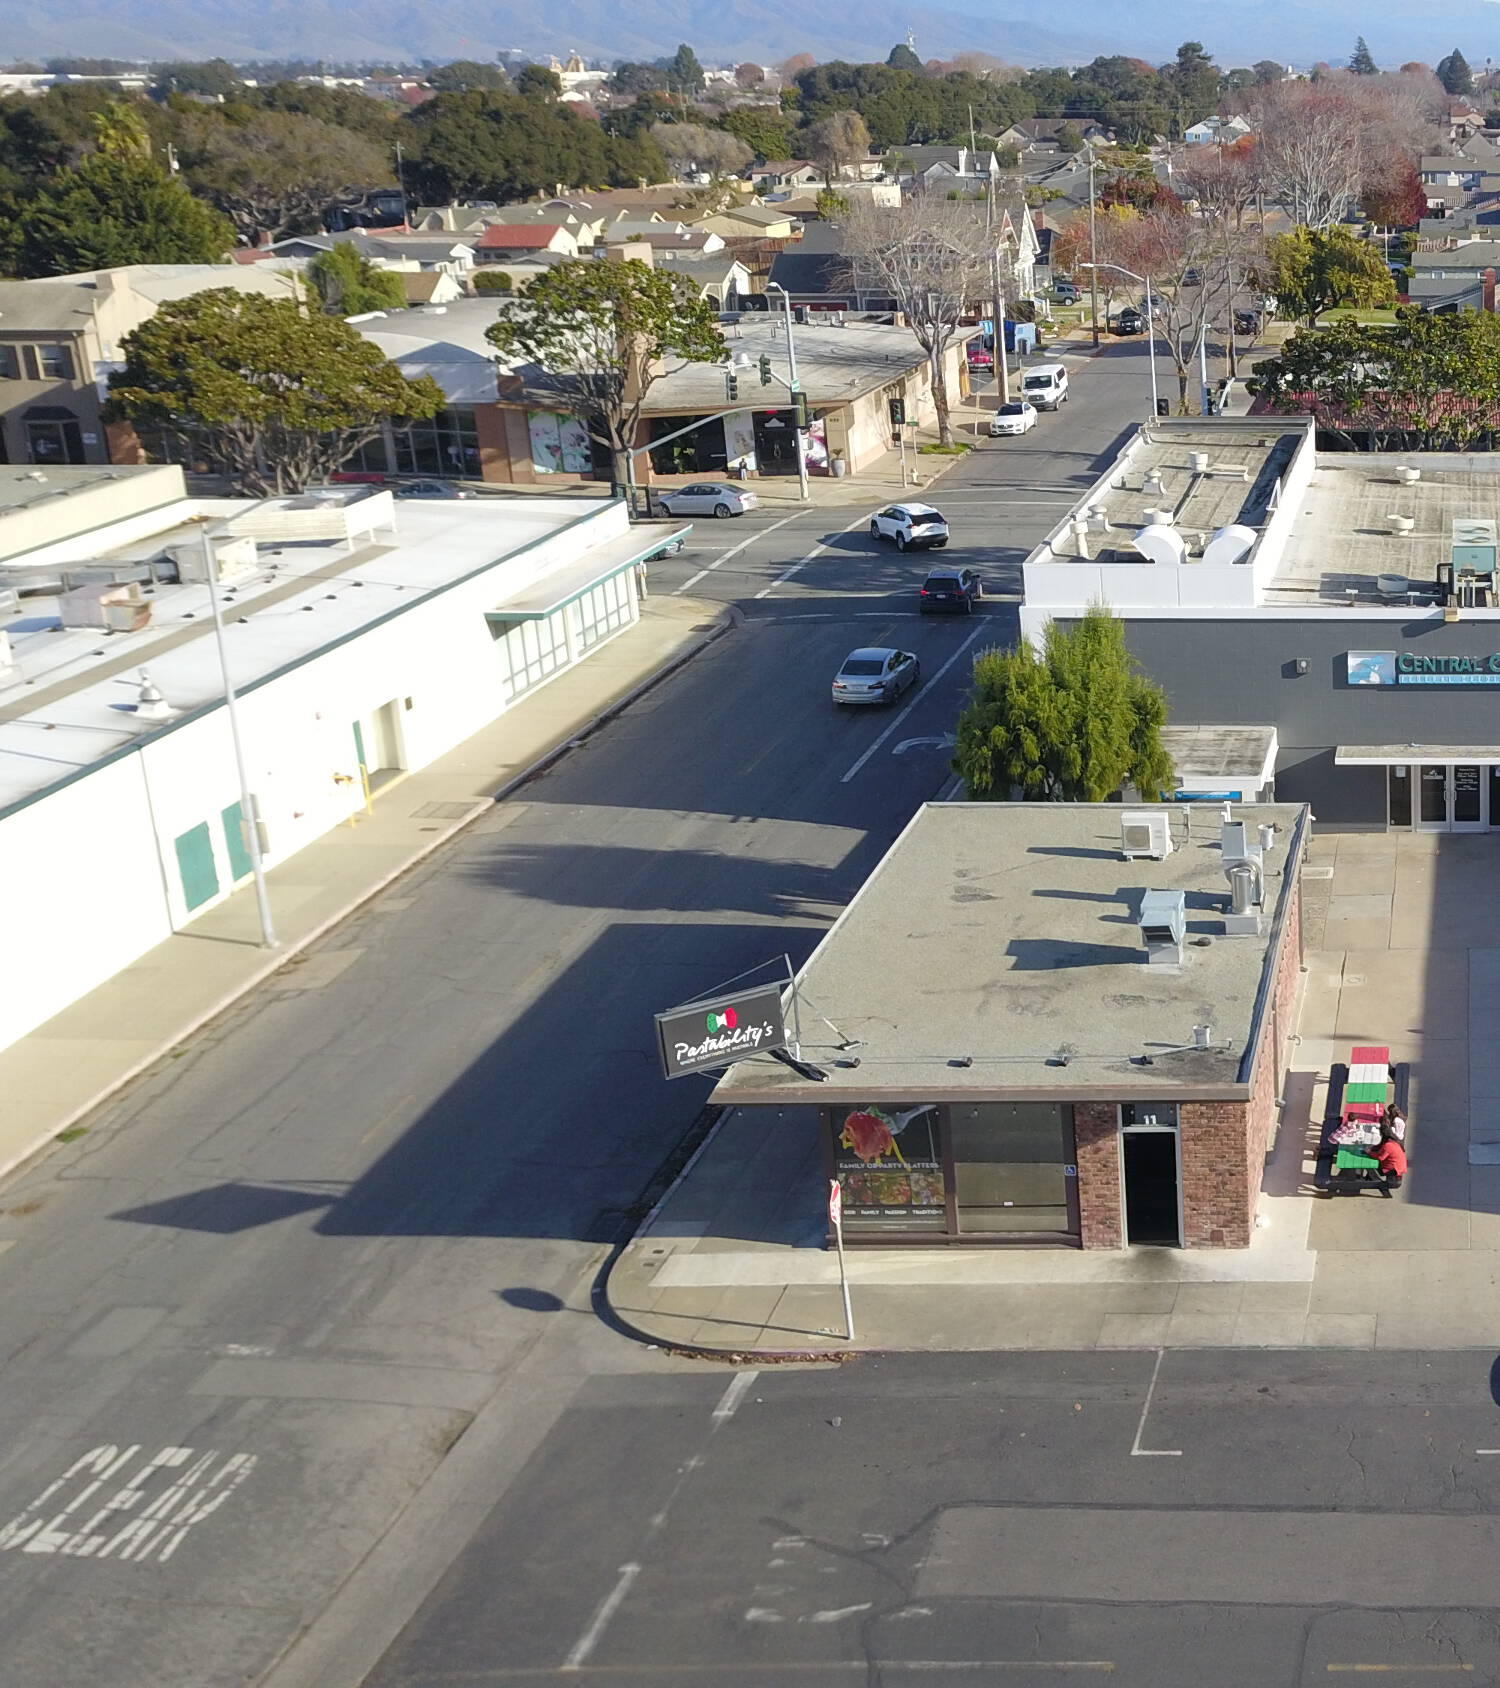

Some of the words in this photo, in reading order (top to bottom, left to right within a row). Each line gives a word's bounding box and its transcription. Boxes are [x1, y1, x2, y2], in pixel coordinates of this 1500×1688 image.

[1398, 652, 1484, 673] CENTRAL
[674, 1021, 774, 1061] Pastability's
[1143, 1114, 1157, 1125] 11
[0, 1444, 258, 1562] CLEAR
